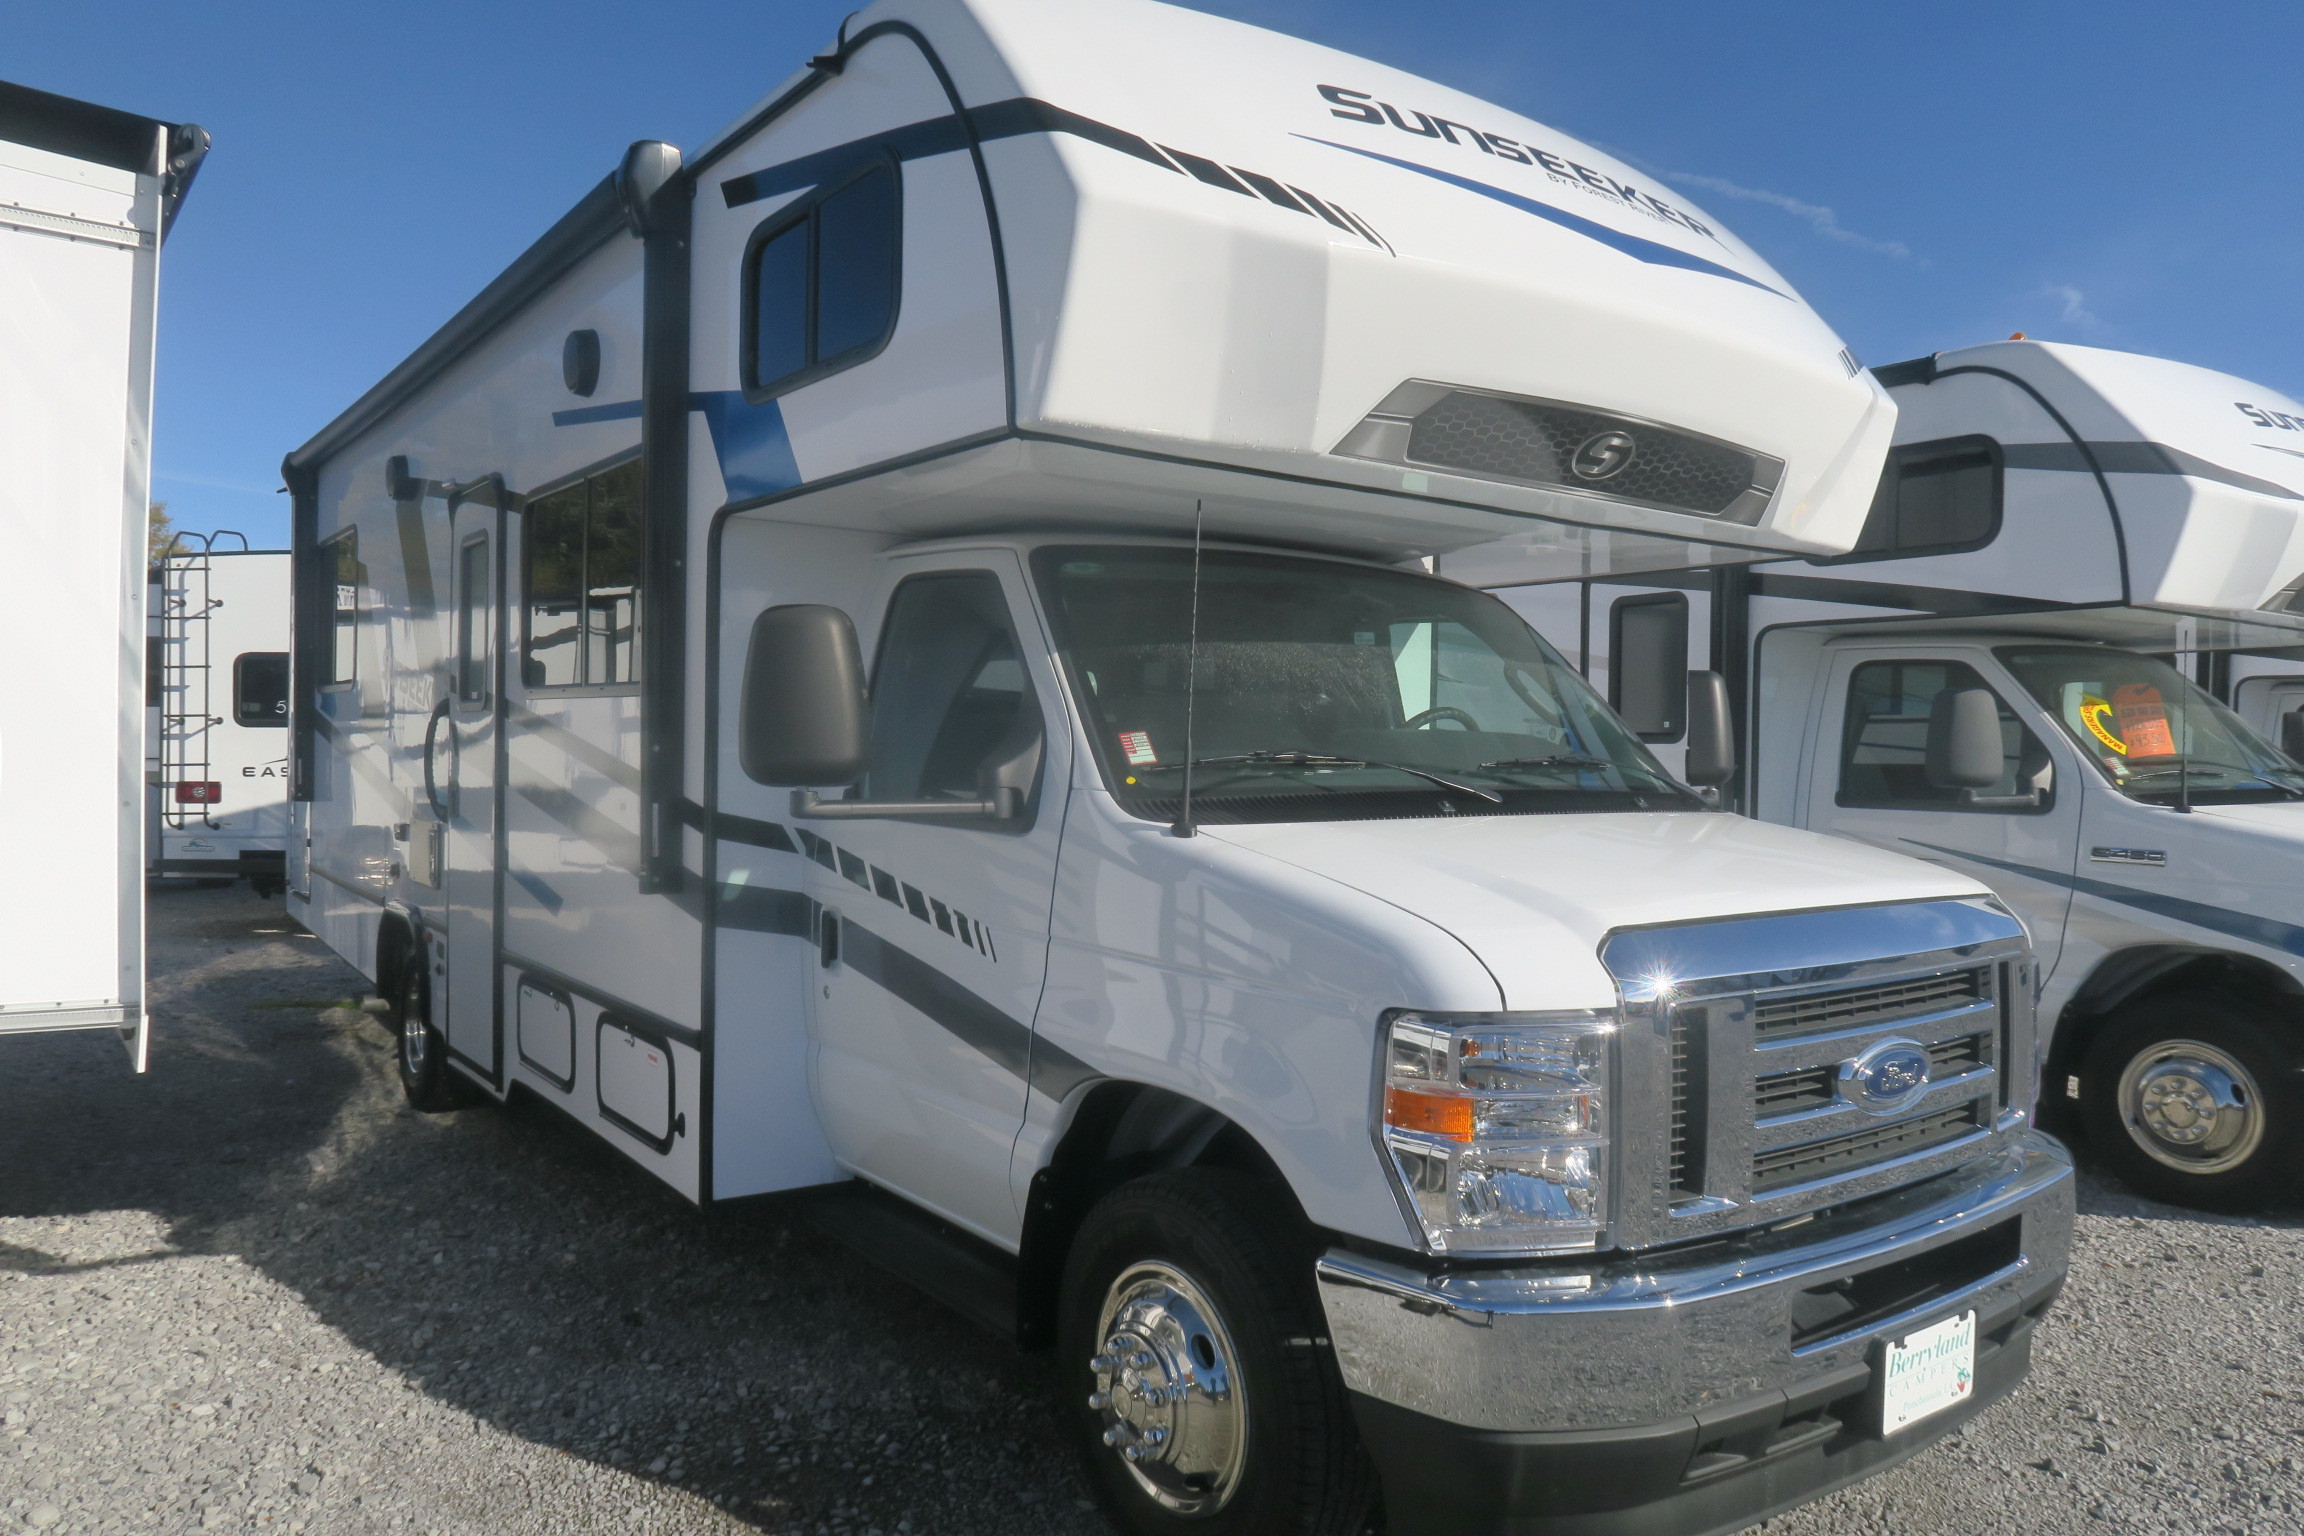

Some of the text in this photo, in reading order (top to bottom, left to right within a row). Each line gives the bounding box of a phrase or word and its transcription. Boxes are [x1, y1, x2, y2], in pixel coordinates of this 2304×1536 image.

[1546, 172, 1568, 186] BY
[1573, 182, 1629, 207] FOREST
[1888, 1321, 1972, 1378] Berryland
